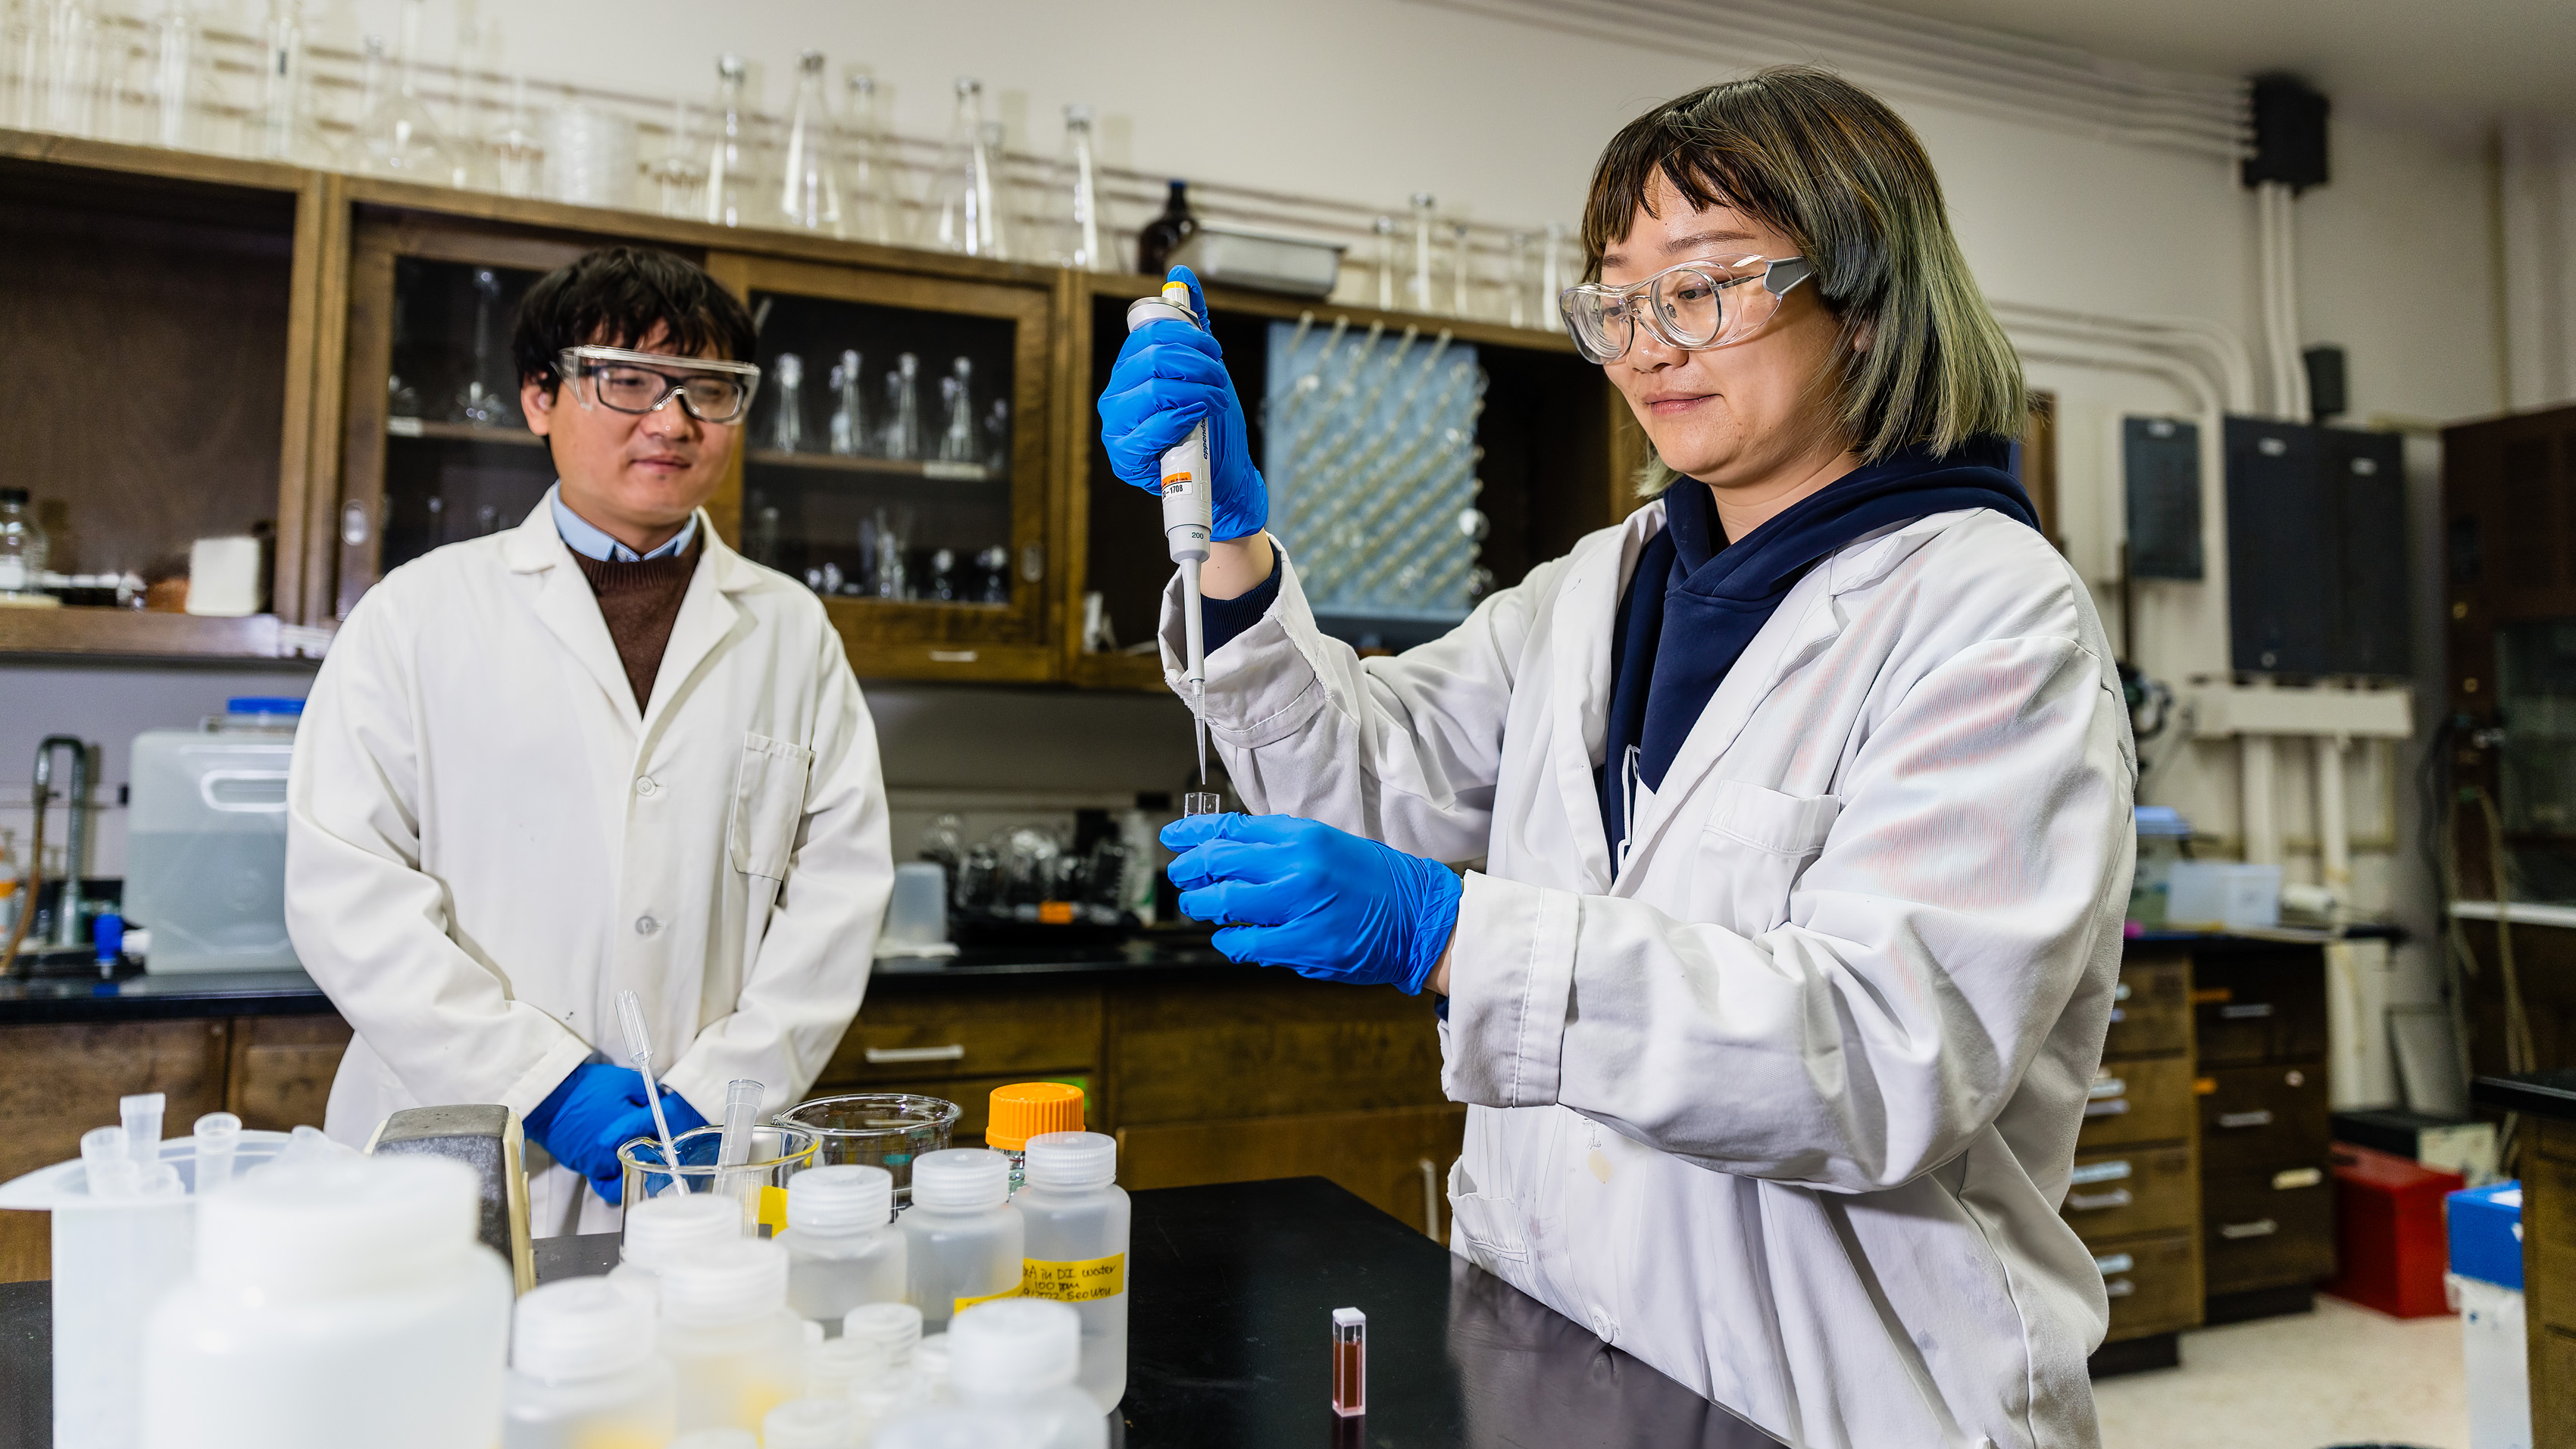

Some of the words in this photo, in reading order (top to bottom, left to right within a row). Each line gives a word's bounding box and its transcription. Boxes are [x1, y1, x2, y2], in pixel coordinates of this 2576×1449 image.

[1057, 1268, 1076, 1280] DI
[1081, 1265, 1117, 1278] water
[1034, 1281, 1055, 1291] 100
